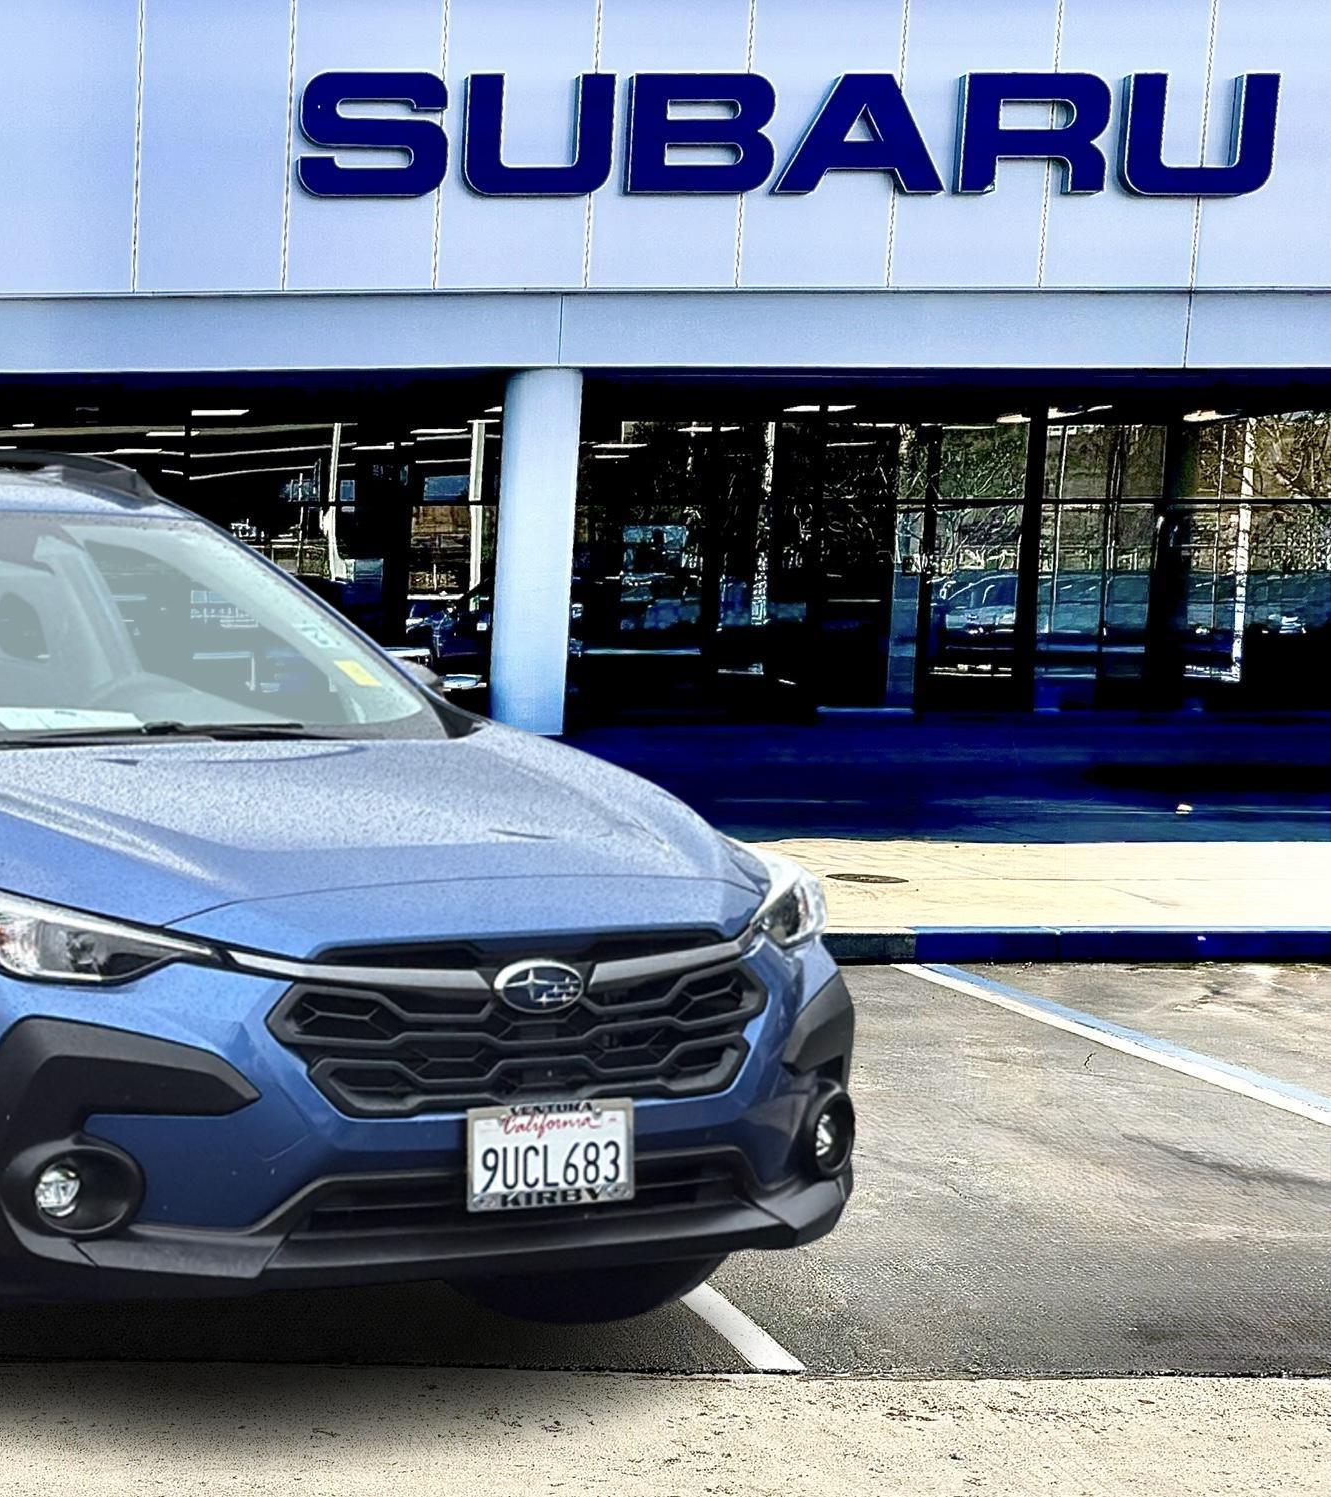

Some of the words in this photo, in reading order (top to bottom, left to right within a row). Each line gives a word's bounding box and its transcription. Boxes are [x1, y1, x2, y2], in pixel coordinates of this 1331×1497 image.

[297, 70, 1283, 197] SUBARU
[501, 1113, 601, 1138] California
[482, 1140, 620, 1193] 9UCL683
[501, 1186, 602, 1207] KIRBY
